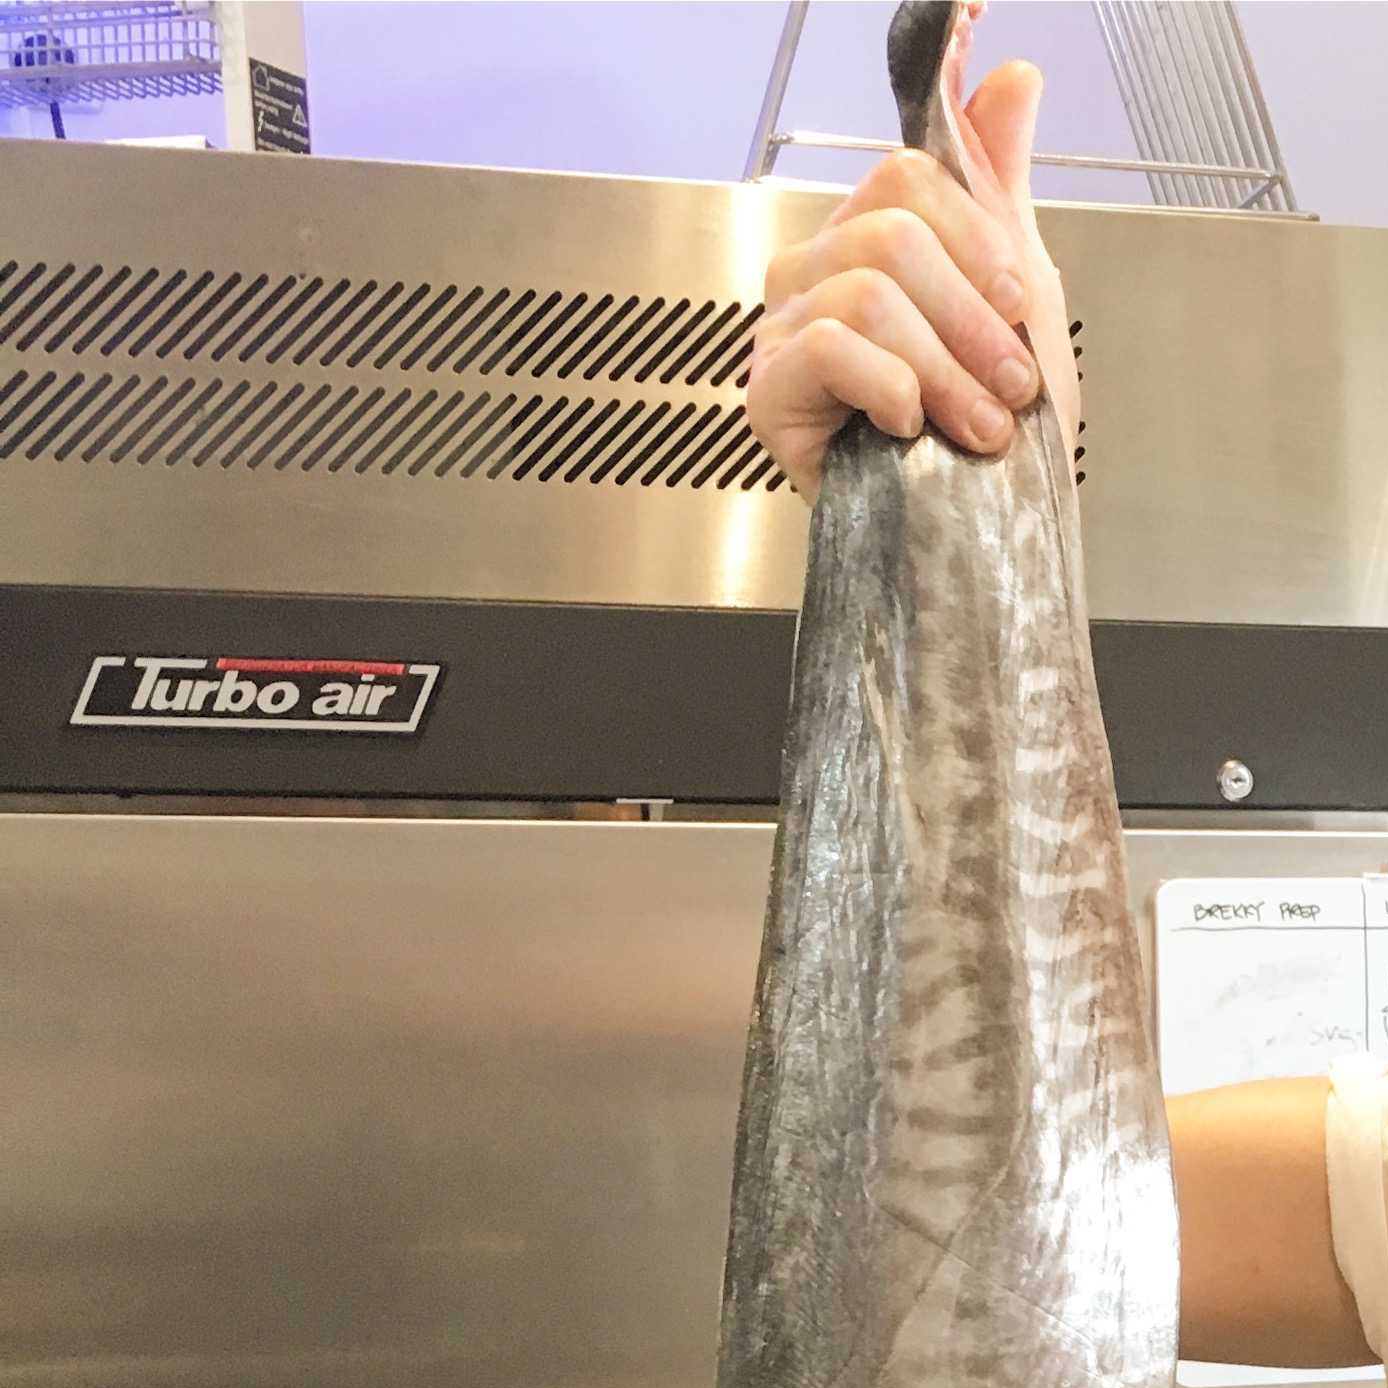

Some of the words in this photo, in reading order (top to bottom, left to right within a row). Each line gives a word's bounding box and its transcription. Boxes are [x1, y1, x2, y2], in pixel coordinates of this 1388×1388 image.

[131, 657, 301, 714] Turbo
[312, 674, 397, 716] air
[1279, 902, 1321, 921] PREP
